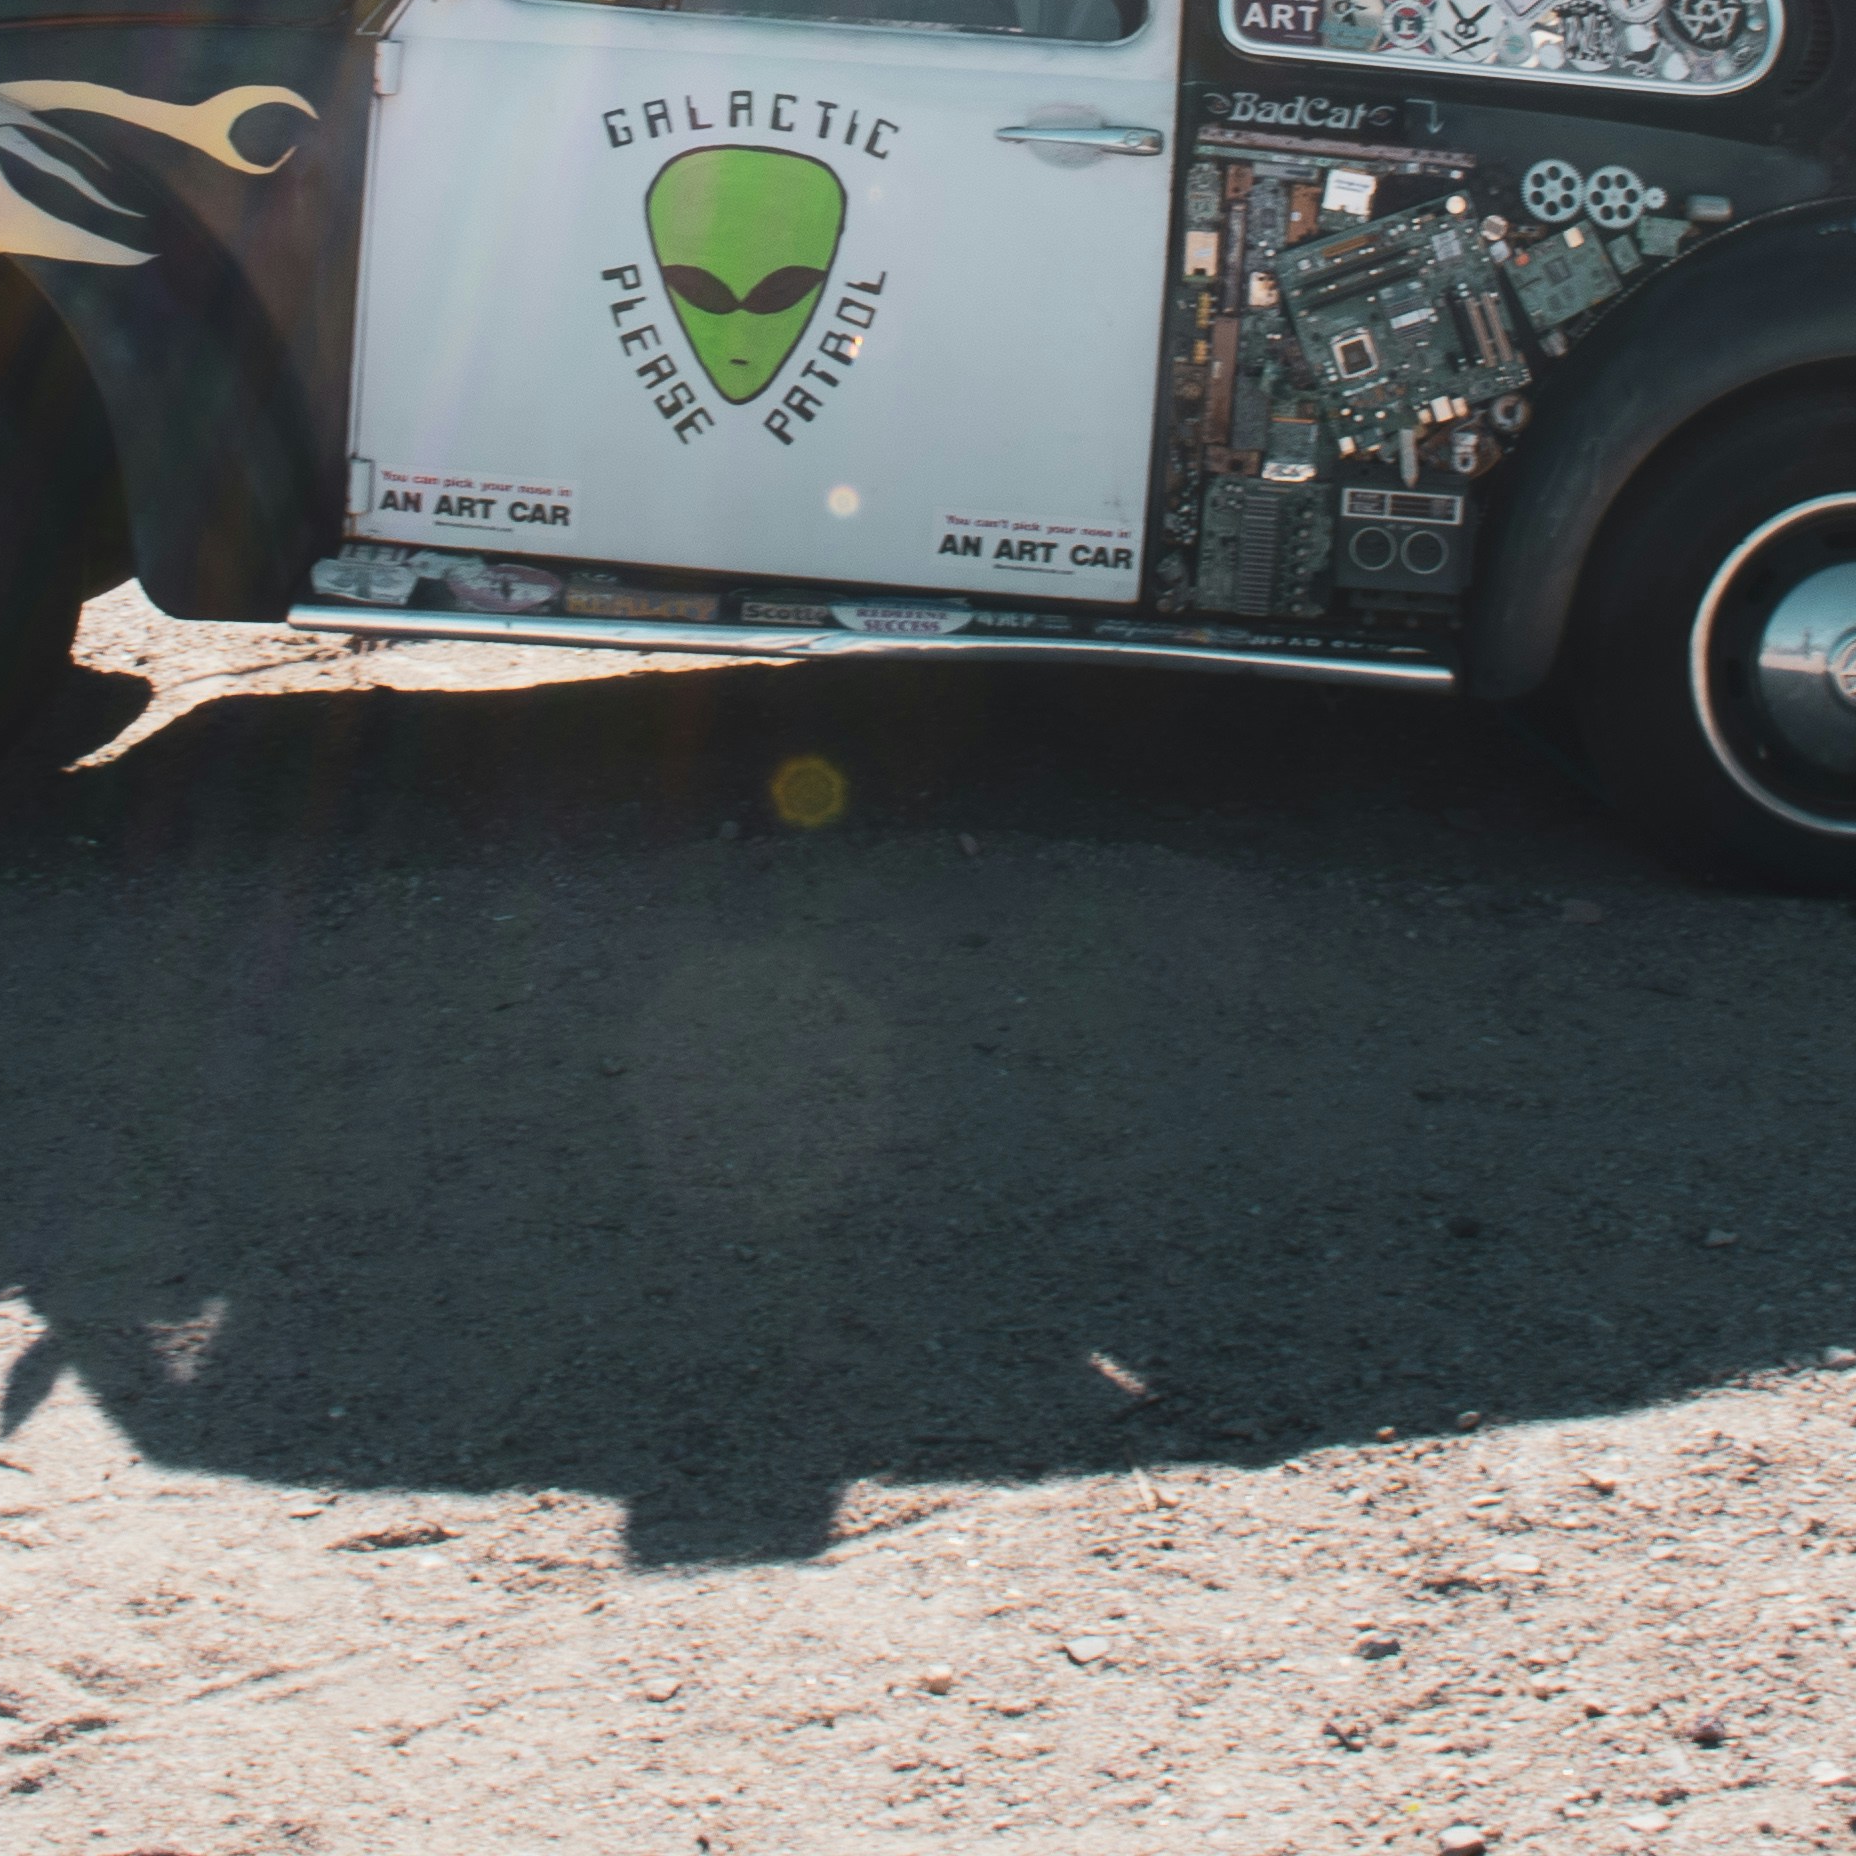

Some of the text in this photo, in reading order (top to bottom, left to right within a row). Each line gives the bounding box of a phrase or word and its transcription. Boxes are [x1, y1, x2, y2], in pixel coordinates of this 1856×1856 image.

[1242, 2, 1319, 32] ART
[602, 90, 901, 160] GALACTIC
[1227, 91, 1368, 130] BadCat
[602, 265, 716, 445] PLEASE
[763, 271, 886, 445] PATROL
[382, 470, 406, 483] You
[412, 474, 439, 486] can
[443, 478, 473, 490] pick
[480, 482, 512, 494] your
[518, 485, 552, 496] nose
[379, 490, 422, 513] AN
[433, 494, 498, 519] ART
[508, 501, 572, 527] CAR
[945, 513, 970, 526] You
[1012, 521, 1041, 533] pick
[1046, 525, 1077, 536] your
[938, 533, 983, 557] AN
[992, 538, 1059, 563] ART
[1070, 544, 1133, 569] CAR
[862, 620, 941, 633] SUCCESS
